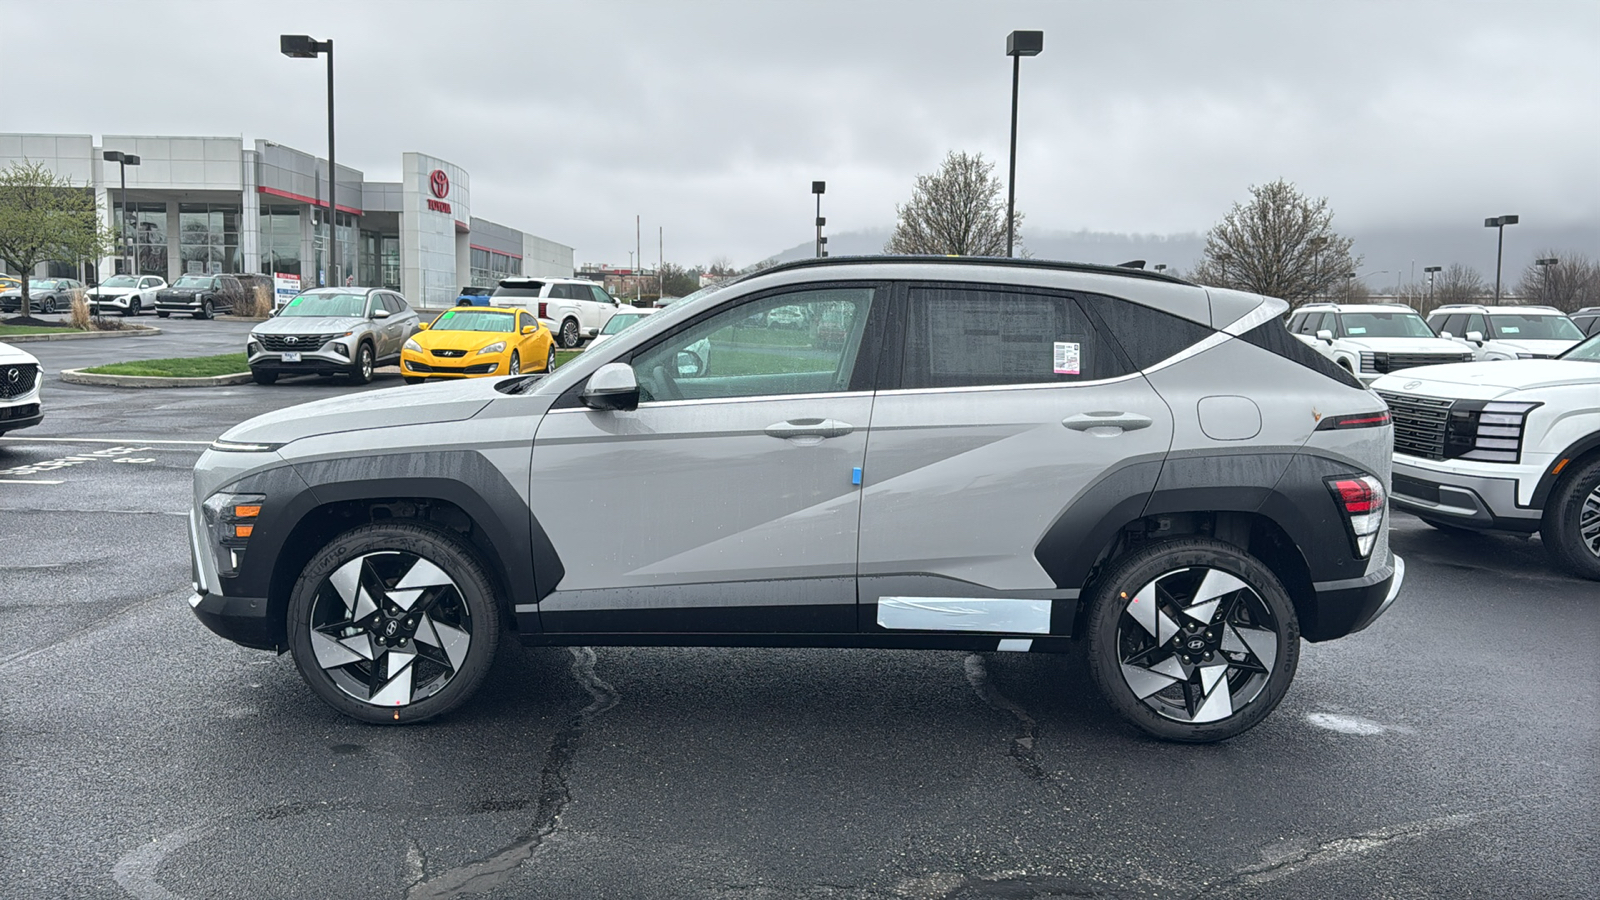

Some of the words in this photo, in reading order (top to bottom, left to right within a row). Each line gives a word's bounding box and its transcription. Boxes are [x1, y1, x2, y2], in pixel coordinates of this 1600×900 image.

[427, 198, 452, 214] TOYOTA
[306, 546, 347, 584] KUMHO
[1283, 620, 1295, 674] KUMHO
